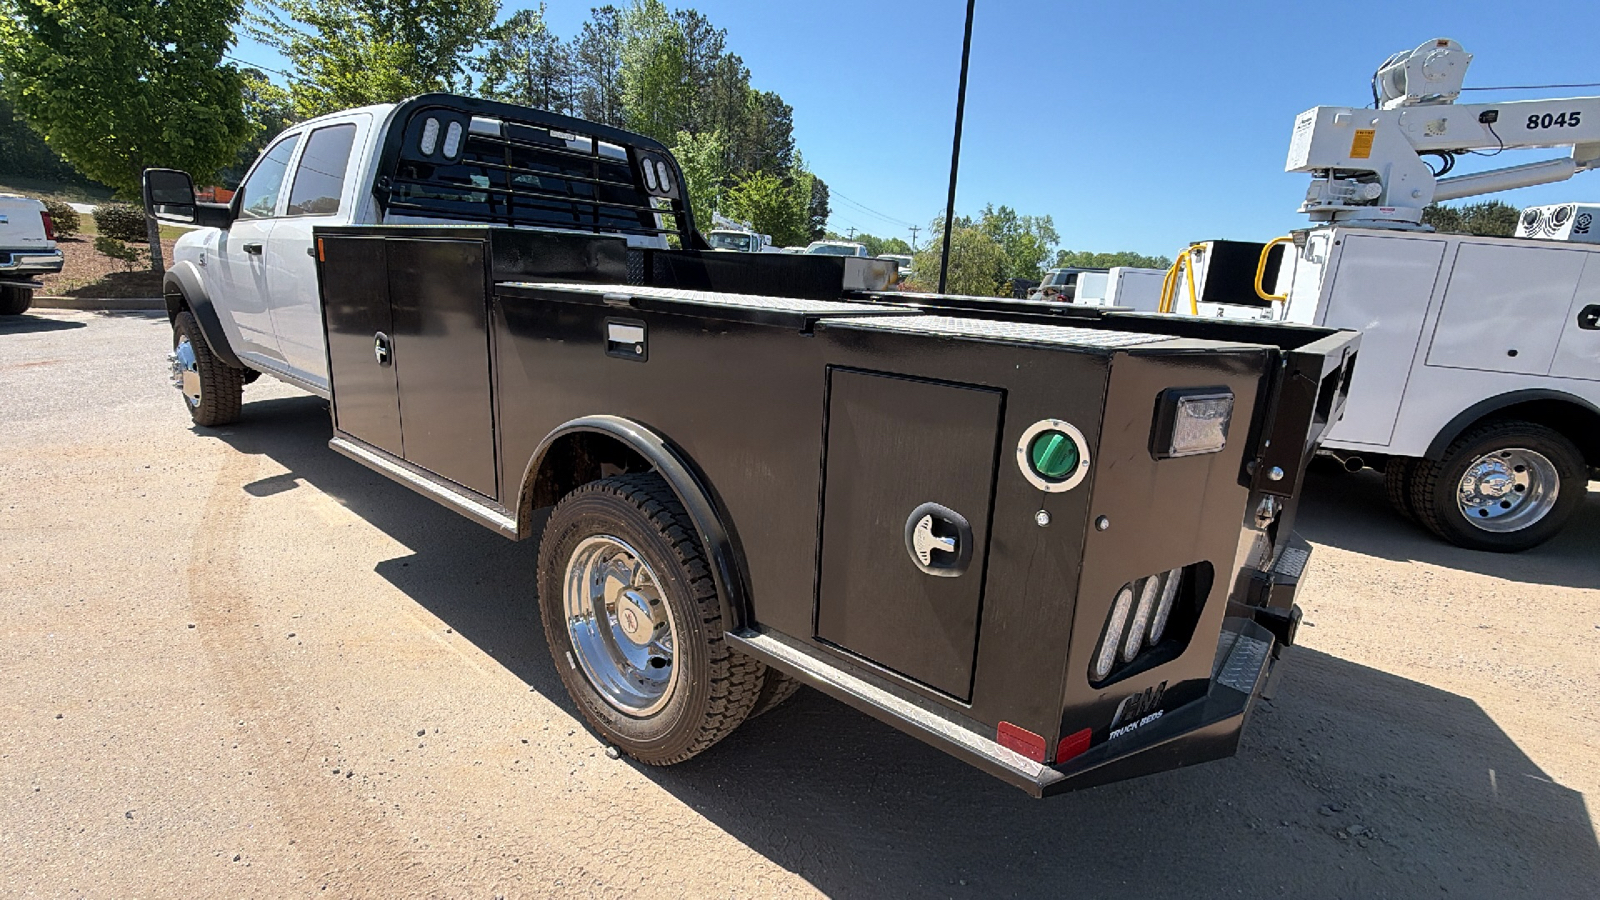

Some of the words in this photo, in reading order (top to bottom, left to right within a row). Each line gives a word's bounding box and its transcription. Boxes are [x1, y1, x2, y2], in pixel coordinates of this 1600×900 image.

[1526, 111, 1581, 130] 8045
[1109, 720, 1139, 741] TRUCK
[1140, 709, 1164, 727] BEDS
